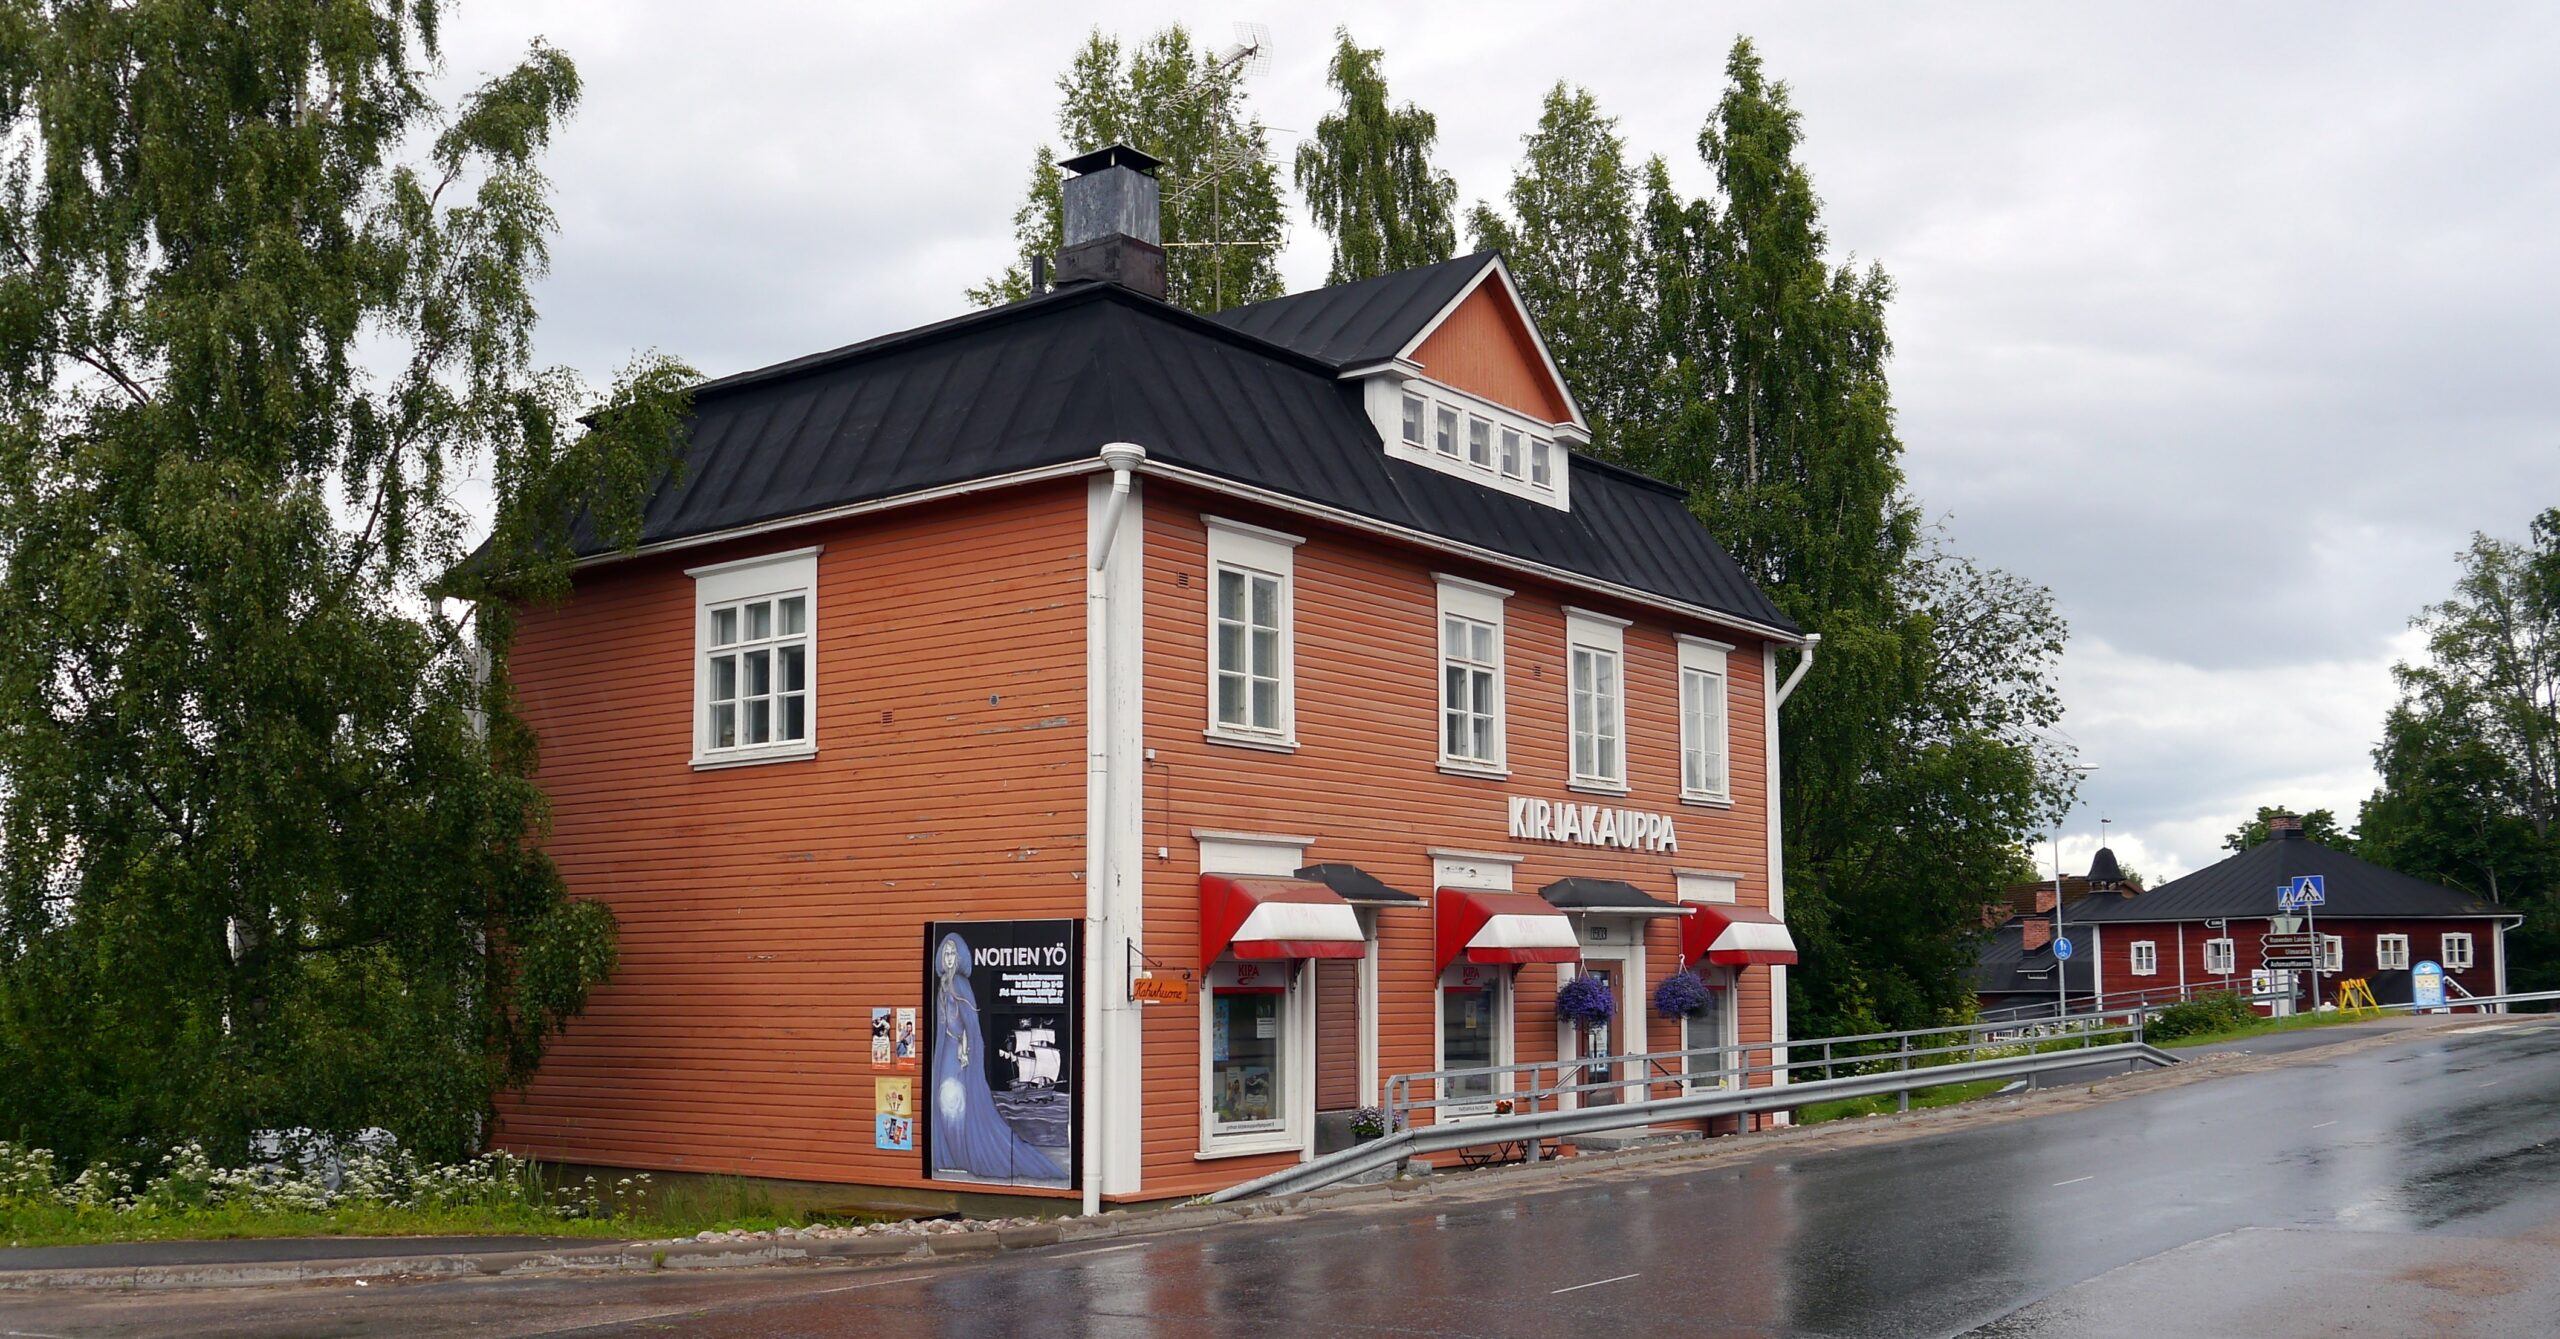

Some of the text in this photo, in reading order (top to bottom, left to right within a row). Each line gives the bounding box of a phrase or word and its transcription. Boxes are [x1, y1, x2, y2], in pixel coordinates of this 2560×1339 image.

[1508, 796, 1678, 852] KIRJAKAUPPA
[974, 942, 1067, 966] NOITIEN YÖ
[1238, 964, 1259, 977] KIPA
[1463, 966, 1479, 979] KIPA
